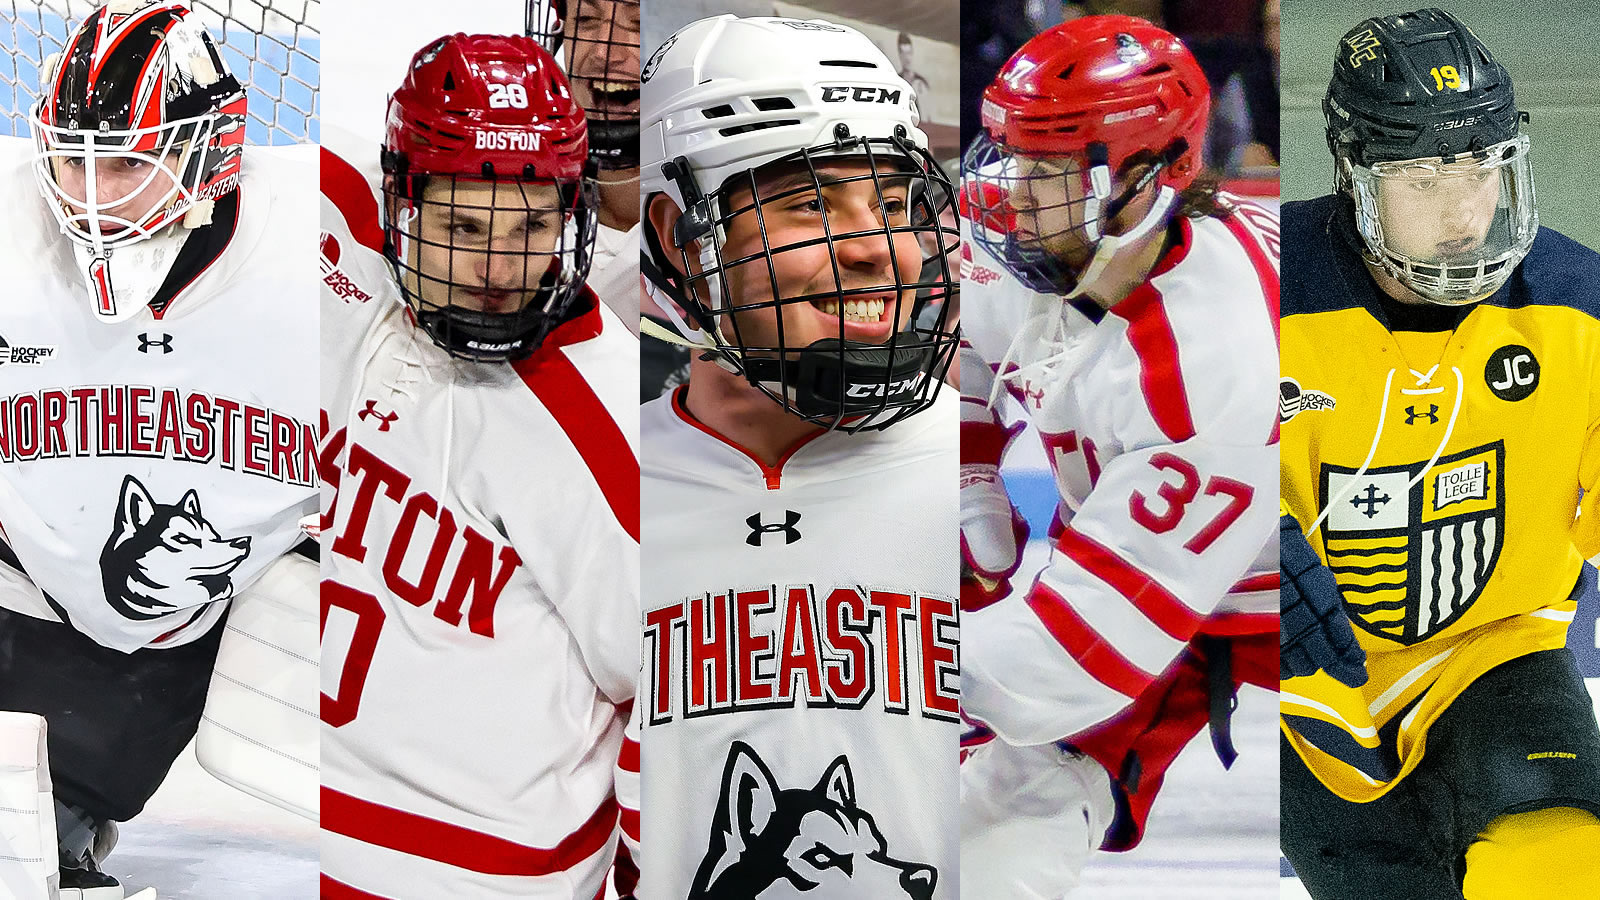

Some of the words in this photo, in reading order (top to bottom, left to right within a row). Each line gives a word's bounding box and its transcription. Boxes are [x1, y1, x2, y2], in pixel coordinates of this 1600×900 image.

[1430, 65, 1461, 91] 19
[487, 83, 528, 109] 20
[821, 86, 901, 105] CCM
[475, 130, 541, 151] BOSTON
[90, 257, 117, 316] 1
[323, 275, 352, 299] EAST
[332, 269, 373, 303] HOCKEY
[11, 354, 38, 364] EAST
[12, 347, 54, 357] HOCKEY
[1493, 354, 1535, 390] JC
[846, 379, 919, 398] CCM
[1300, 401, 1324, 411] EAST
[1301, 394, 1336, 408] HOCKEY
[1442, 467, 1481, 487] TOLLE
[1445, 481, 1477, 499] LEGE
[1128, 451, 1254, 555] 37
[320, 408, 522, 638] STON
[642, 584, 960, 724] THEASTE
